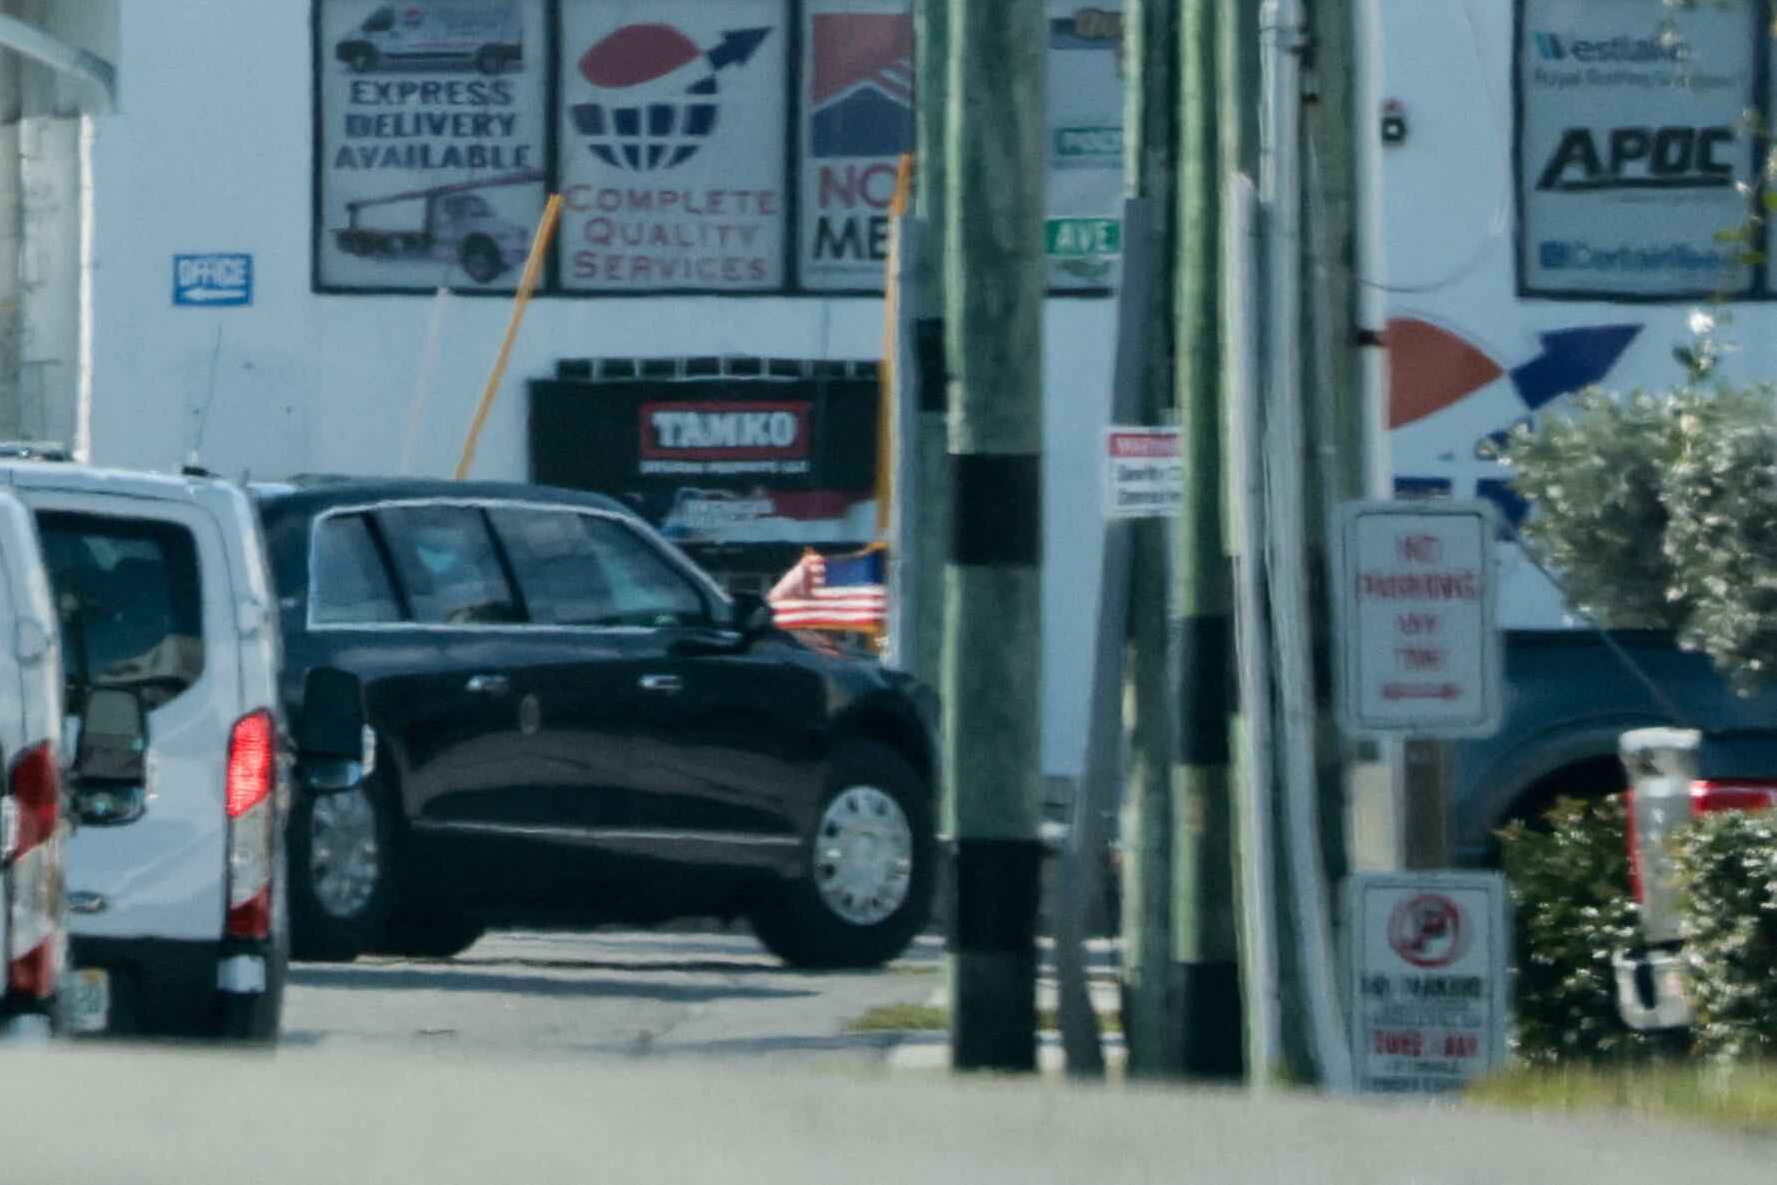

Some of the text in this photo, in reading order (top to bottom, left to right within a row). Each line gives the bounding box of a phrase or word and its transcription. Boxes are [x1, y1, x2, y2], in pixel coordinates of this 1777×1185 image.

[349, 80, 515, 105] EXPRESS
[343, 113, 516, 138] DELIVERY
[333, 144, 531, 170] AVAILABLE
[1536, 126, 1735, 190] APOC
[565, 183, 778, 216] COMPLETE
[817, 163, 897, 209] NO
[583, 216, 763, 248] QUALITY
[812, 216, 890, 261] ME
[1055, 221, 1112, 252] AVE
[178, 258, 247, 287] OFFICE
[573, 250, 768, 282] SERVICES
[650, 411, 798, 448] TAMKO
